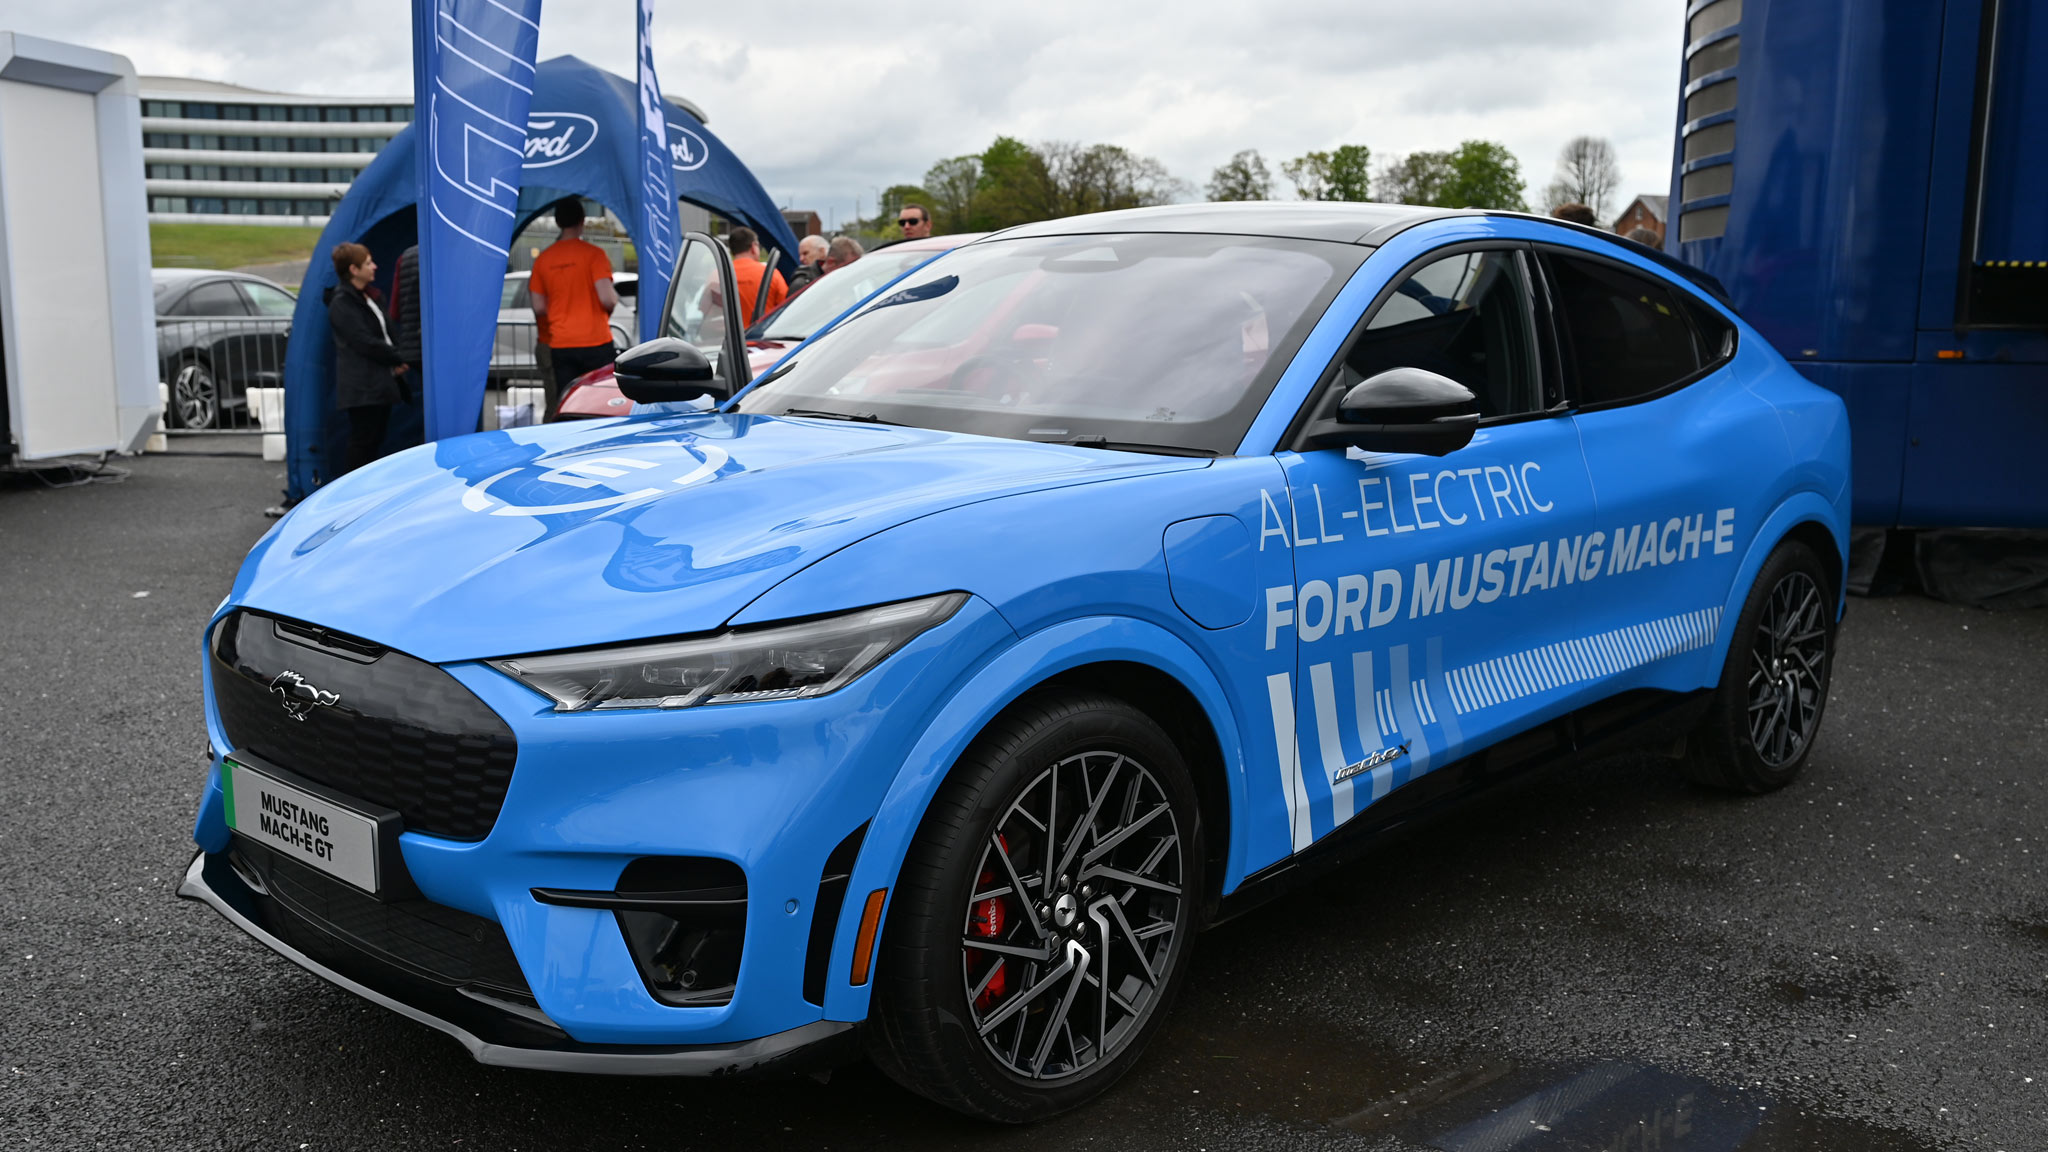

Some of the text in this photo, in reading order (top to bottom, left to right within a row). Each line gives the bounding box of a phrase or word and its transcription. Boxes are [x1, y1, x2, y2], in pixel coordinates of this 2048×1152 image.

[1259, 461, 1554, 552] ALL-ELECTRIC
[1265, 508, 1735, 651] FORD MUSTANG MACH-E
[260, 813, 333, 861] MACH-E GT
[261, 791, 329, 836] MUSTANG
[988, 897, 997, 938] rembo
